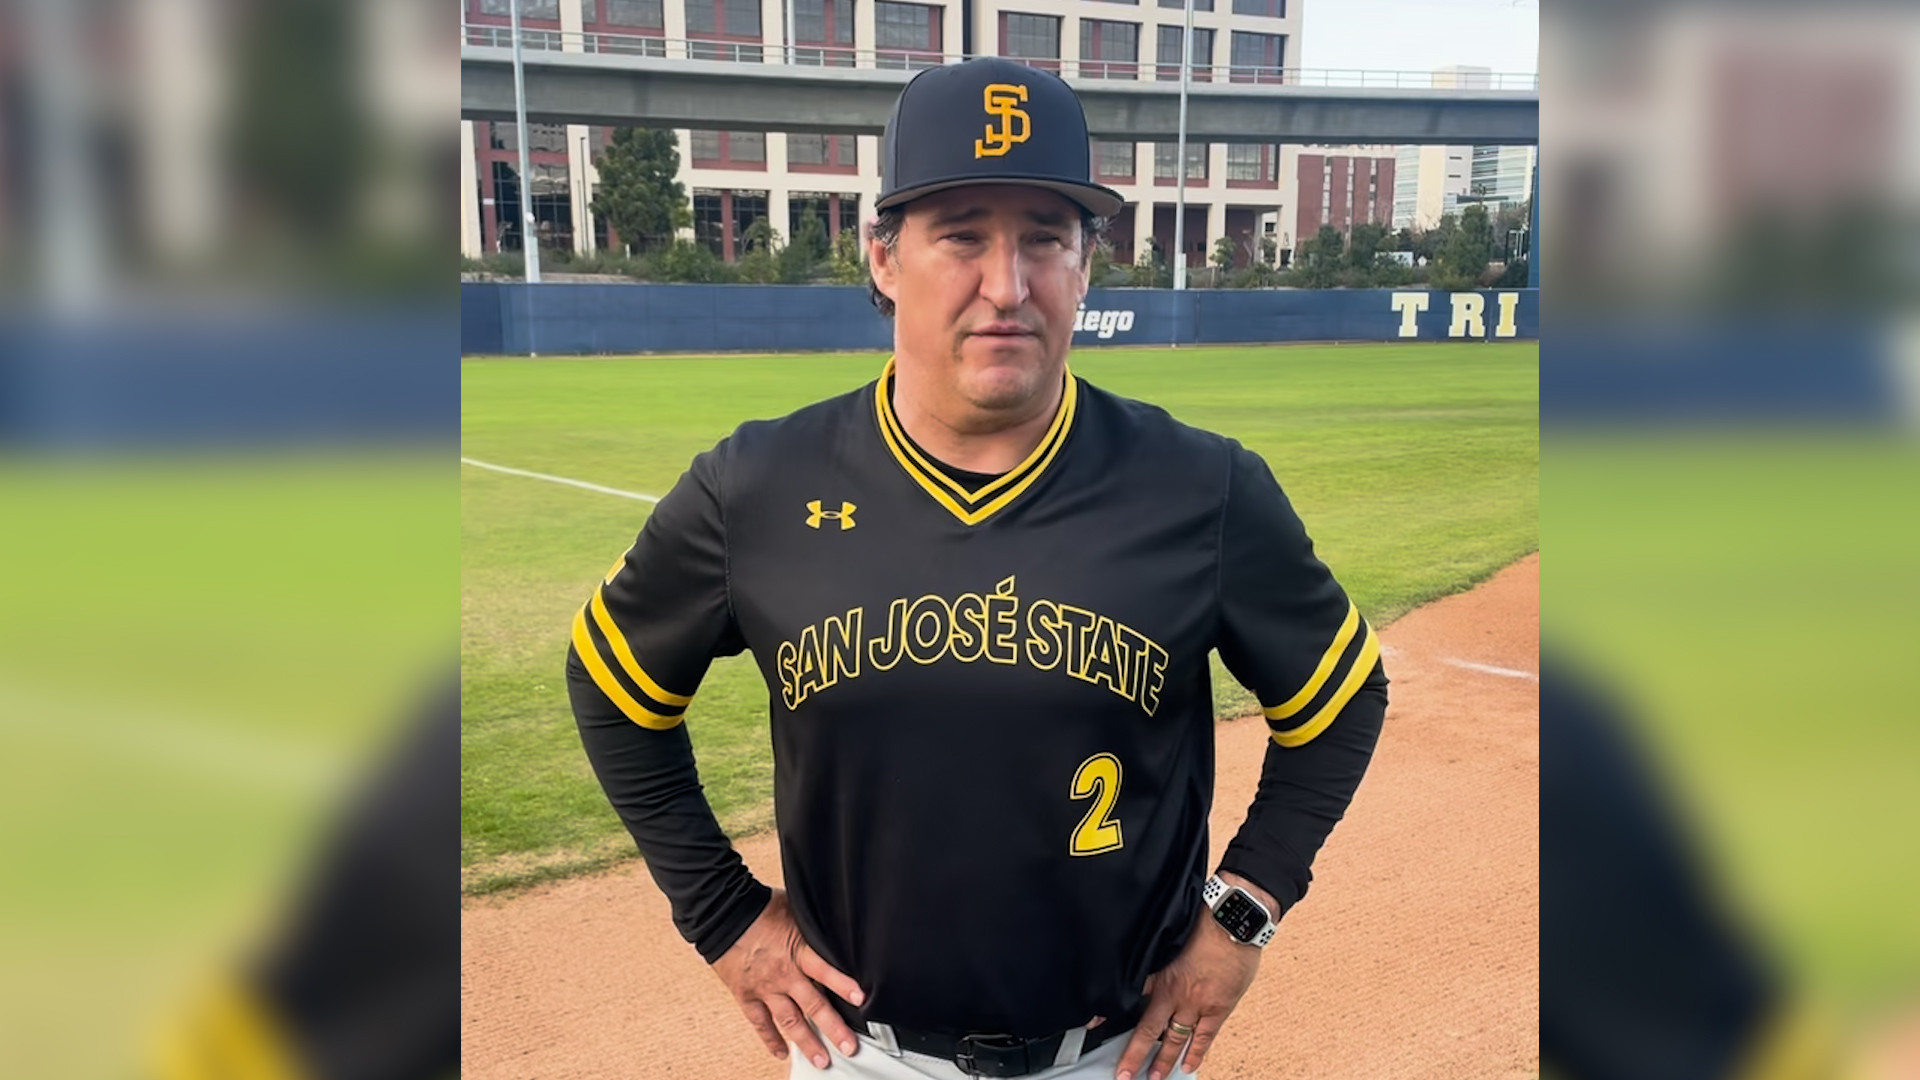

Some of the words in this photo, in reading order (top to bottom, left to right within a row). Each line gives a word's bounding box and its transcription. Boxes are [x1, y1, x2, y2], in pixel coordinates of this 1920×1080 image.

[1072, 302, 1136, 339] iego
[777, 607, 863, 711] SAN
[868, 575, 1019, 670] JOSÉ
[1026, 599, 1169, 717] STATE
[1069, 752, 1124, 856] 2
